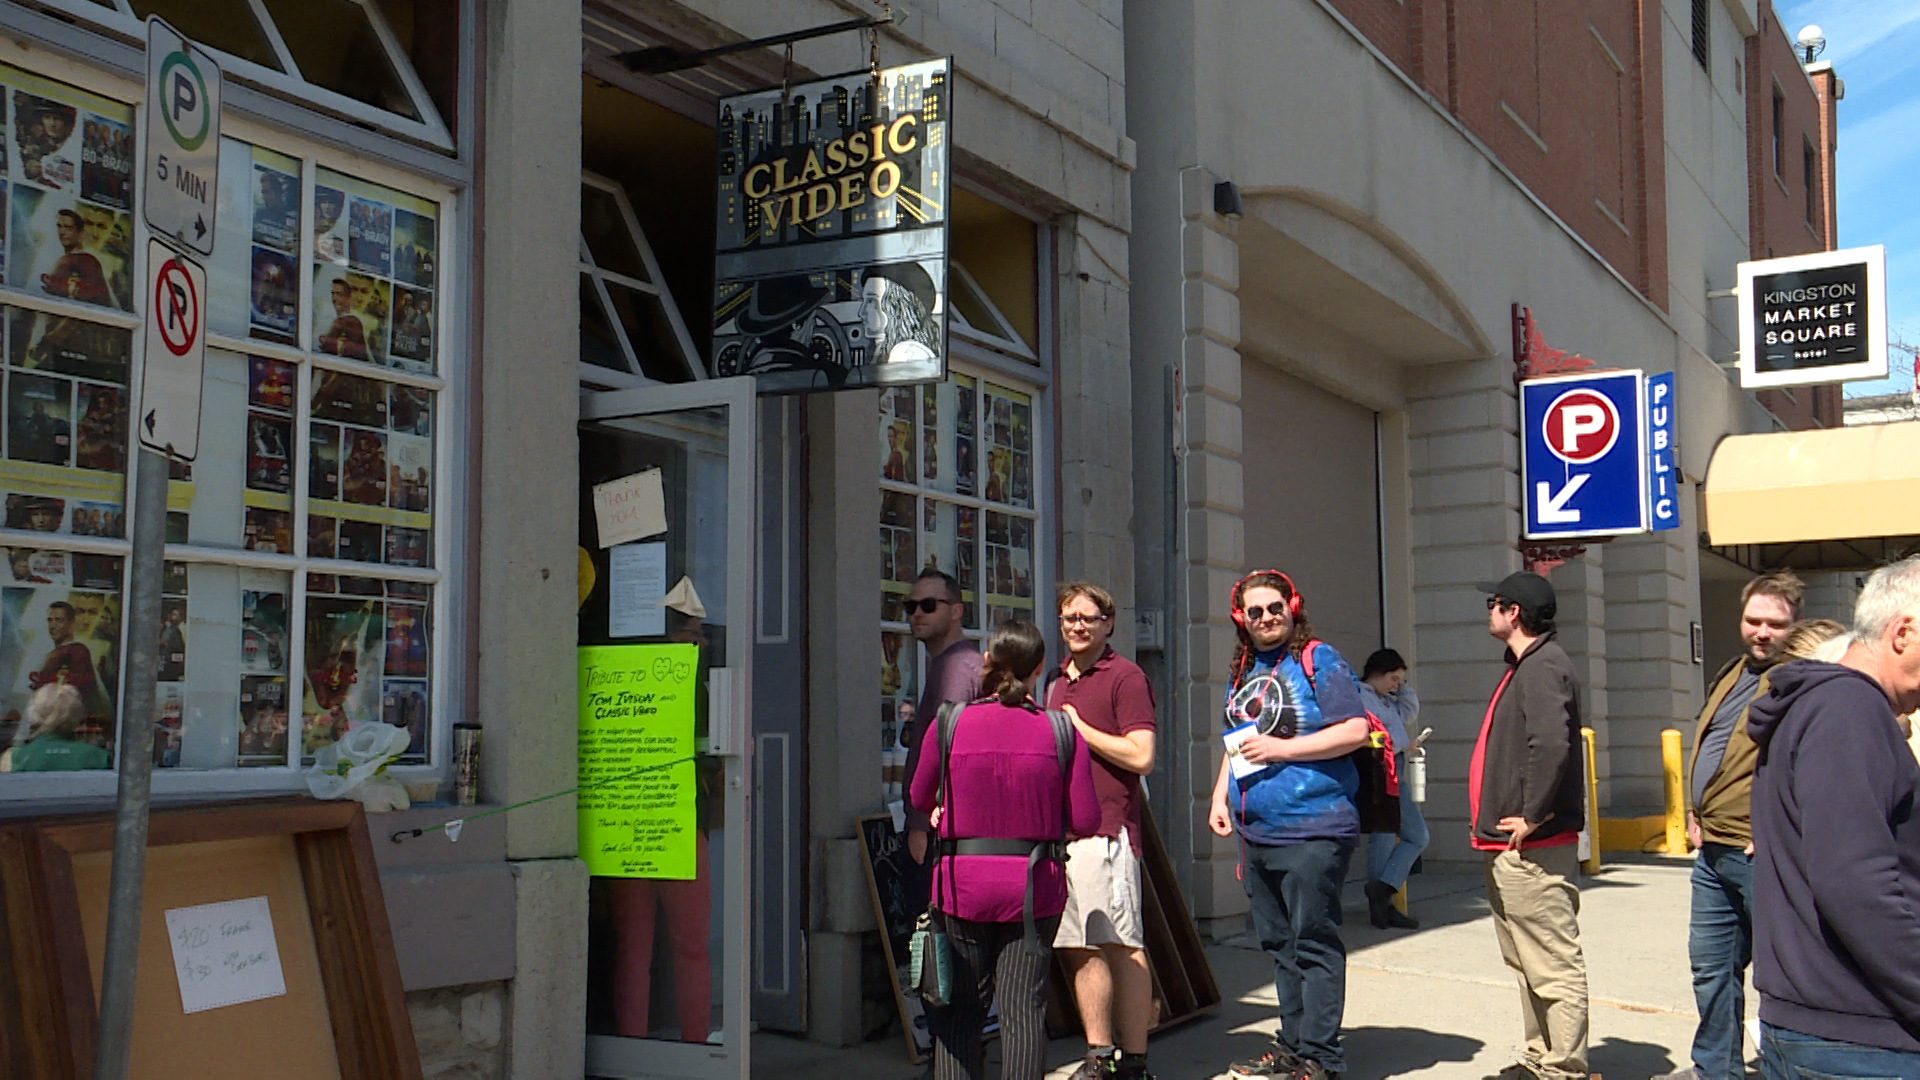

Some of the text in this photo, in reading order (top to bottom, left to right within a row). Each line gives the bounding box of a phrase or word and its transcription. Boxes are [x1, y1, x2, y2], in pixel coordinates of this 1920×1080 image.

[174, 71, 196, 122] P
[157, 154, 206, 204] 5 MIN
[744, 113, 916, 200] CLASSIC
[760, 161, 901, 231] VIDEO
[1764, 283, 1857, 304] KINGSTON
[1764, 301, 1857, 325] MARKET
[1765, 322, 1858, 345] SQUARE
[1794, 349, 1828, 360] hotel
[1560, 404, 1606, 452] P
[1653, 383, 1673, 520] PUBLIC
[630, 669, 647, 683] TO
